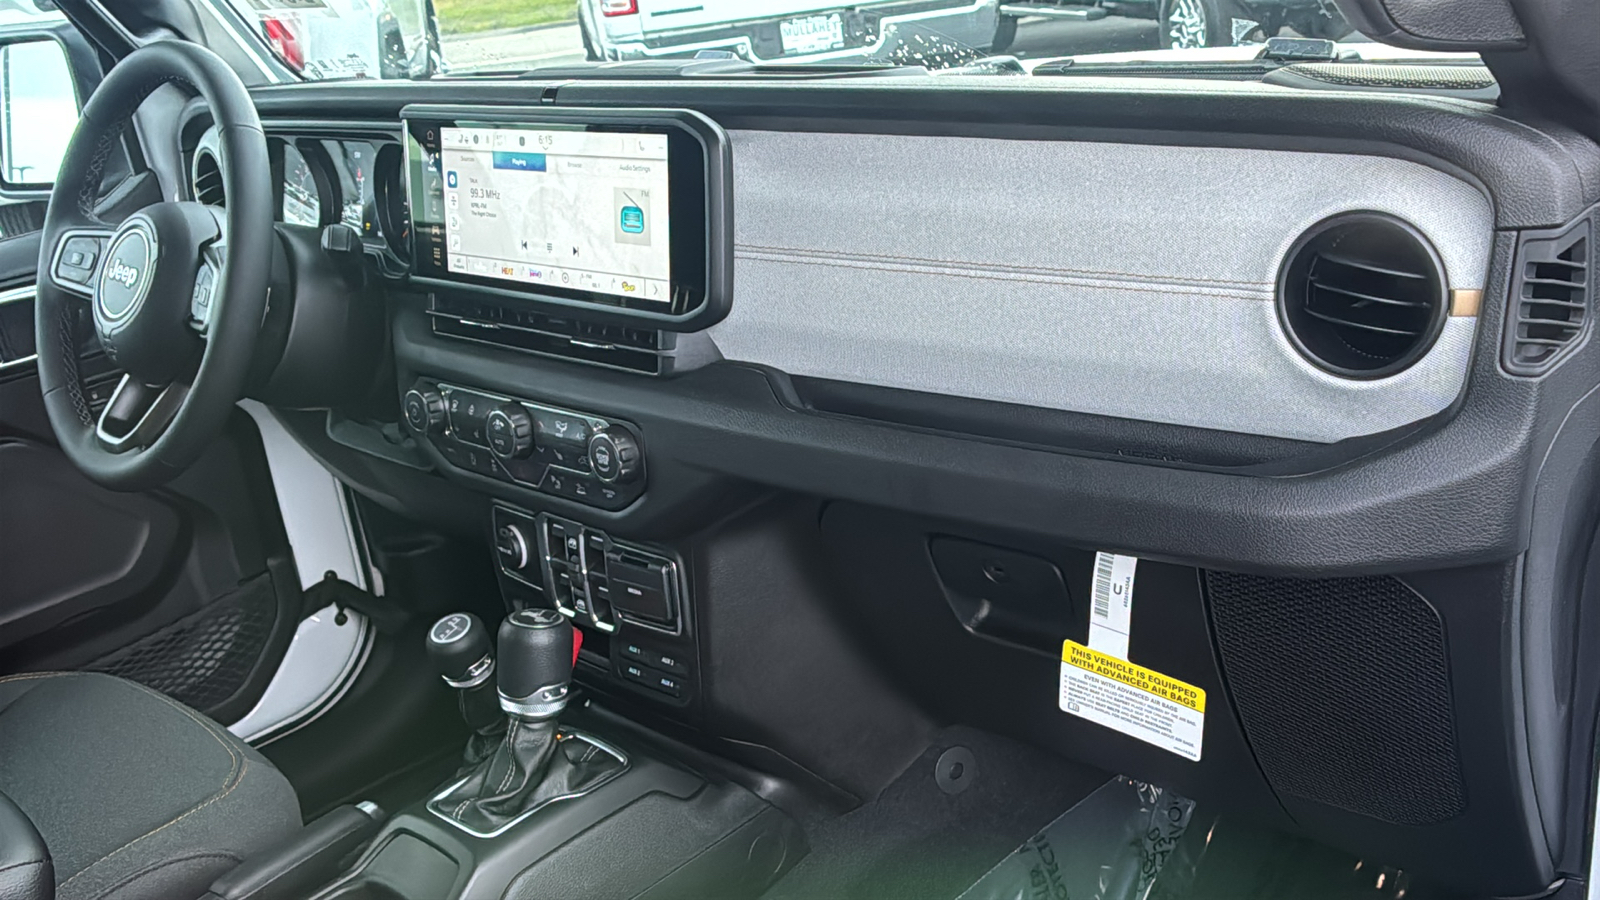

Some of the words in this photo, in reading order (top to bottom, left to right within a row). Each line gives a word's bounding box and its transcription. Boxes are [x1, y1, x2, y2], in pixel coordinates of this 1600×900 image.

[538, 134, 553, 145] 6:15
[633, 165, 651, 174] Settings
[470, 188, 485, 199] 99.3
[485, 189, 500, 200] MHz
[108, 258, 138, 288] Jeep
[1070, 655, 1094, 670] WITH
[1096, 666, 1149, 689] ADVANCED
[1152, 686, 1168, 698] AIR
[1170, 692, 1197, 708] BAGS
[1071, 646, 1091, 660] THIS
[1094, 655, 1134, 676] VEHICLE
[1136, 670, 1146, 680] IS
[1148, 675, 1197, 698] EQUIPPED
[1084, 673, 1099, 683] EVEN
[1100, 679, 1115, 689] WITH
[1117, 685, 1149, 702] ADVANCED
[1150, 698, 1160, 706] AIR
[1161, 702, 1177, 712] BAGS
